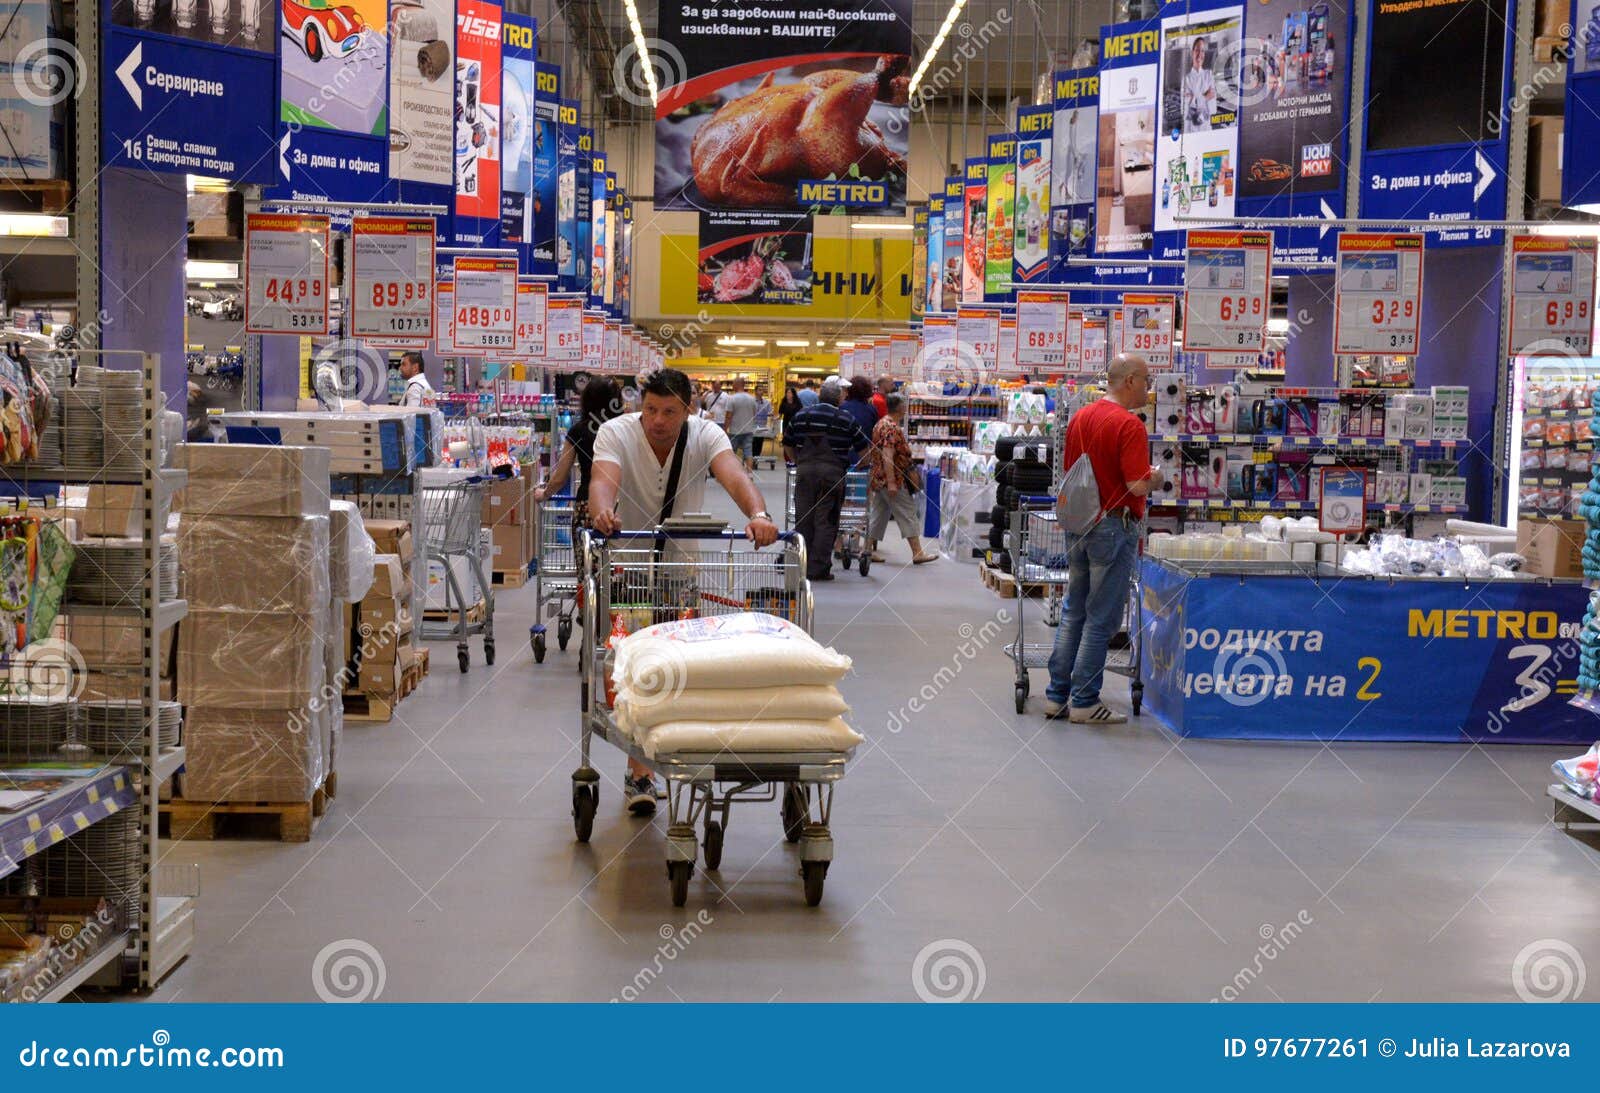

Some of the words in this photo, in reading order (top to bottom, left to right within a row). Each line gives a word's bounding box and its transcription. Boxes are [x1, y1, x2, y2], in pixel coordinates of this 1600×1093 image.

[681, 6, 698, 17] За
[702, 8, 718, 19] да
[721, 7, 796, 20] задоволим
[799, 9, 897, 22] най-високите
[681, 24, 761, 36] изисквания
[772, 25, 836, 37] ВАШИТЕ!
[145, 65, 225, 97] Сервиране
[1277, 97, 1308, 107] МОТОРНИ
[1309, 94, 1332, 104] МАСЛА
[1211, 113, 1236, 124] METRO
[1259, 110, 1287, 122] ДОБАВКИ
[1299, 105, 1332, 117] ГЕРМАНИЯ
[147, 134, 181, 153] Свещи,
[184, 142, 217, 157] сламки
[1302, 145, 1332, 160] LIQUI
[147, 148, 201, 167] Еднократна
[203, 158, 235, 173] посуда
[293, 149, 308, 165] За
[310, 155, 336, 171] дома
[340, 159, 346, 169] и
[349, 157, 380, 175] офиса
[1301, 160, 1332, 176] MOLY
[1372, 175, 1387, 190] За
[1390, 173, 1420, 191] дома
[1424, 174, 1430, 185] и
[1434, 170, 1473, 188] офиса
[801, 184, 885, 203] METRO
[250, 219, 298, 228] ПРОМОЦИЯ
[355, 222, 404, 232] ПРОМОЦИЯ
[407, 223, 432, 231] METRO
[1189, 237, 1239, 245] ПРОМОЦИЯ
[1341, 239, 1391, 247] ПРОМОЦИЯ
[1439, 231, 1469, 241] Лепила
[1163, 247, 1180, 258] Авто
[1515, 241, 1565, 250] ПРОМОЦИЯ
[266, 278, 321, 305] 44,99
[373, 282, 426, 307] 89,99
[764, 291, 803, 299] METRO
[1220, 296, 1261, 321] 6,99
[1372, 299, 1413, 325] 3,29
[1546, 300, 1587, 326] 6,99
[458, 307, 511, 327] 489,00
[1029, 332, 1063, 347] 68,99
[1134, 334, 1169, 349] 39,99
[1408, 608, 1558, 639] METRO
[1305, 673, 1347, 697] на
[1356, 656, 1382, 701] 2
